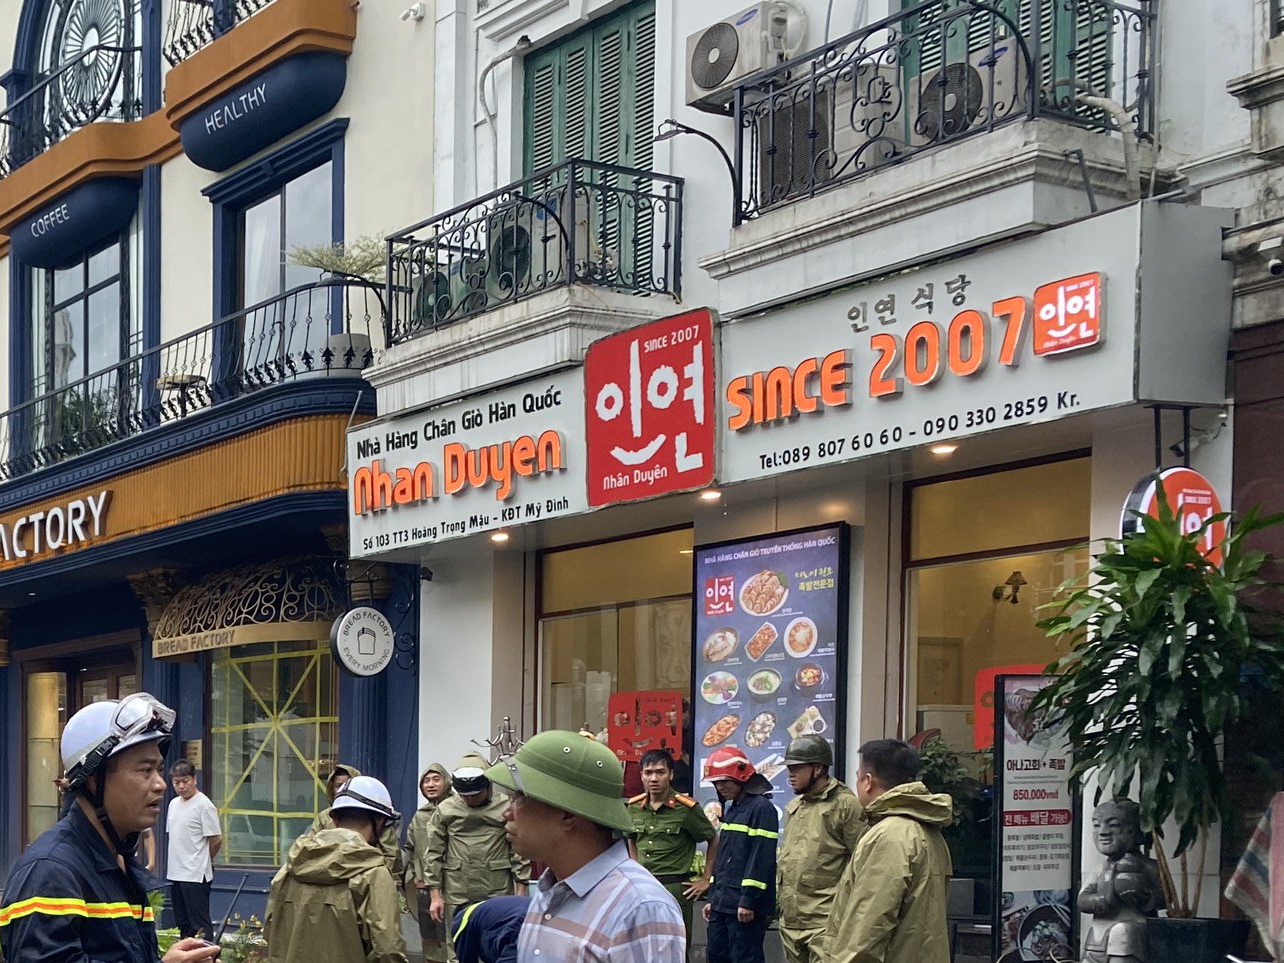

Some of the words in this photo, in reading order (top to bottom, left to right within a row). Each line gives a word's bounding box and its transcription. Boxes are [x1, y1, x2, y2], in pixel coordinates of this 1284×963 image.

[205, 82, 266, 135] HEALTHY
[30, 203, 70, 237] COFFEE
[847, 294, 897, 333] 인연
[911, 274, 972, 314] 식당
[644, 335, 667, 353] SINCE
[671, 325, 699, 346] 2007
[726, 349, 848, 431] SINCE
[869, 295, 1028, 398] 2007
[357, 438, 381, 459] Nhà
[386, 429, 418, 452] Hàng
[423, 418, 456, 441] Chân
[461, 408, 483, 430] Giò
[488, 401, 516, 424] Hàn
[522, 385, 561, 413] Quốc
[759, 446, 811, 470] Tel:089
[818, 438, 845, 458] 807
[923, 414, 958, 436] 090
[965, 406, 997, 428] 330
[1003, 395, 1048, 421] 2859
[1057, 391, 1080, 410] Kr.
[354, 459, 435, 516] Nhan
[443, 429, 562, 501] Duyen
[603, 472, 630, 490] Nhân
[633, 464, 667, 486] Duyên
[363, 536, 373, 550] Số
[375, 532, 390, 547] 103
[392, 528, 409, 545] TT3
[411, 524, 437, 540] Hoàng
[441, 519, 466, 535] Trọng
[469, 513, 489, 530] Mậu
[501, 505, 521, 522] KĐT
[525, 500, 541, 518] Mỹ
[546, 496, 569, 513] Đình
[343, 612, 362, 636] BREAD
[363, 611, 391, 637] FACTORY
[157, 638, 188, 655] BREAD
[190, 629, 235, 649] FACTORY
[343, 646, 362, 669] EVERY
[362, 648, 390, 671] MORNING
[1049, 758, 1066, 770] 족발
[1030, 811, 1049, 825] 배달
